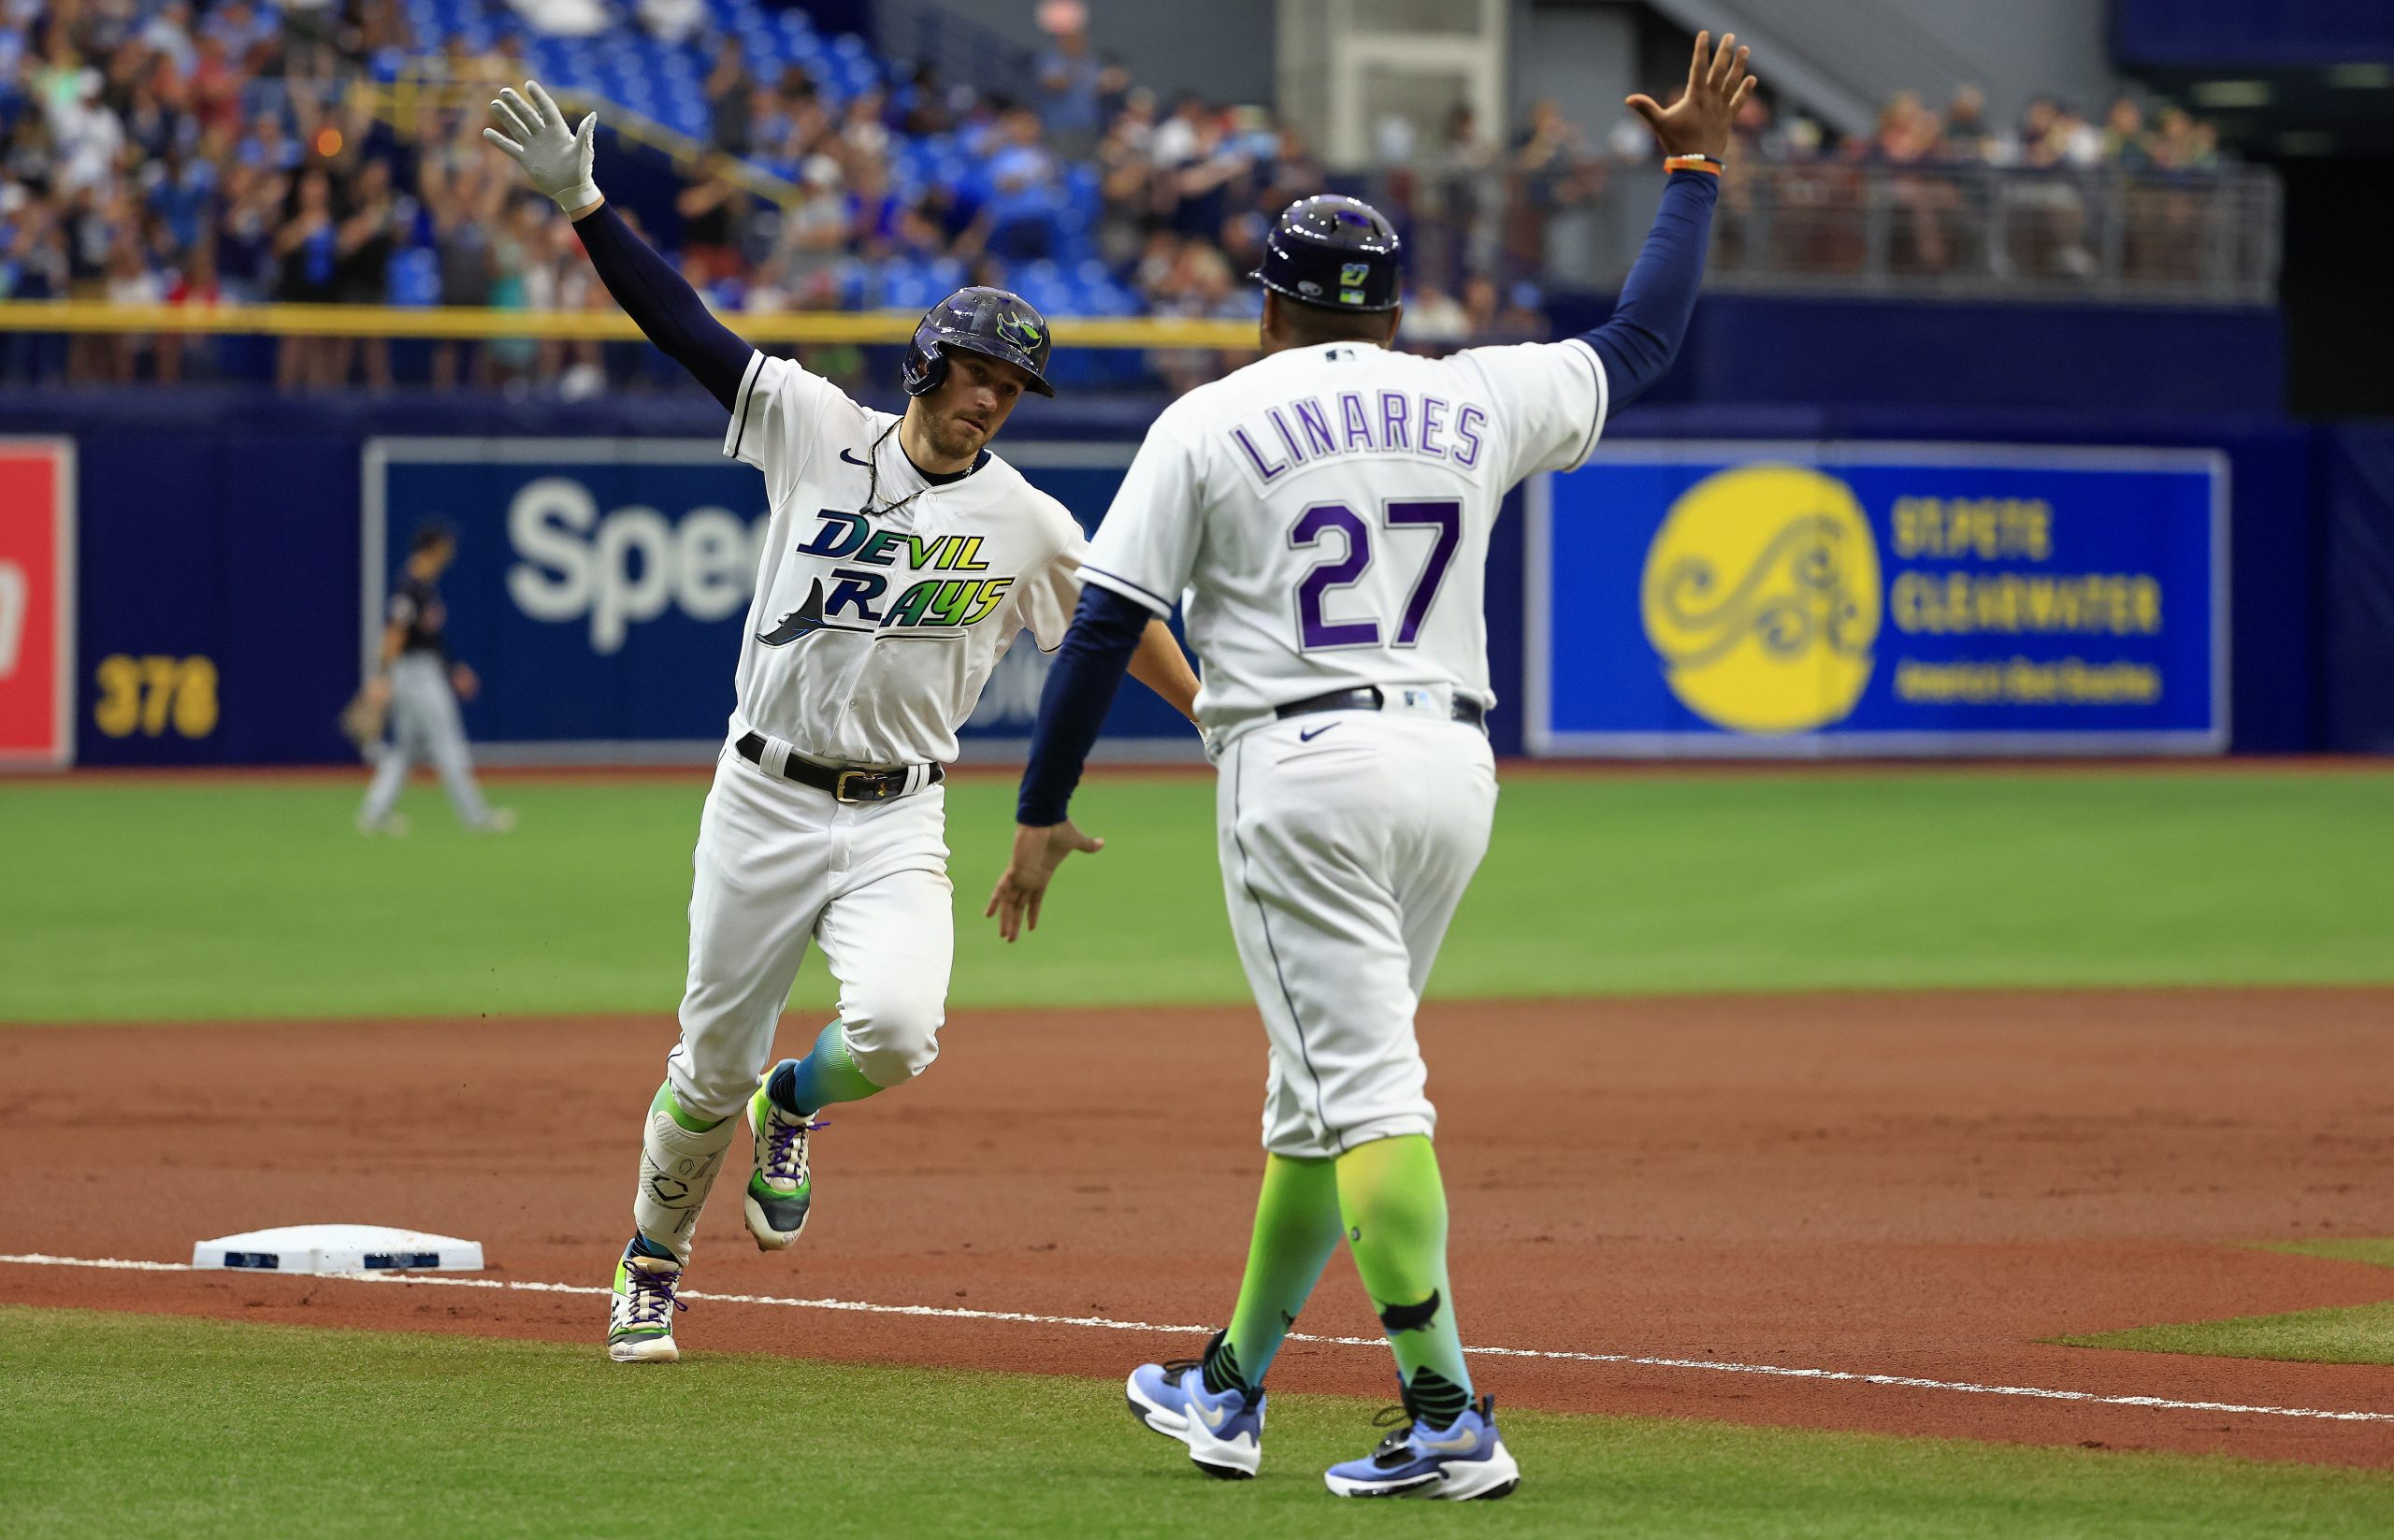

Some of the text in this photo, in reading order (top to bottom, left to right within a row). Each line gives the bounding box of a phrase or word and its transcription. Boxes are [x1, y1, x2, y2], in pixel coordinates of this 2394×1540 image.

[1340, 263, 1369, 286] 27
[1229, 389, 1488, 484] LINARES
[795, 508, 989, 571] DEVIL
[825, 567, 1016, 628] RAYS
[1287, 497, 1464, 654] 27
[1891, 570, 2163, 635] CLEARWATER
[94, 655, 219, 738] 378
